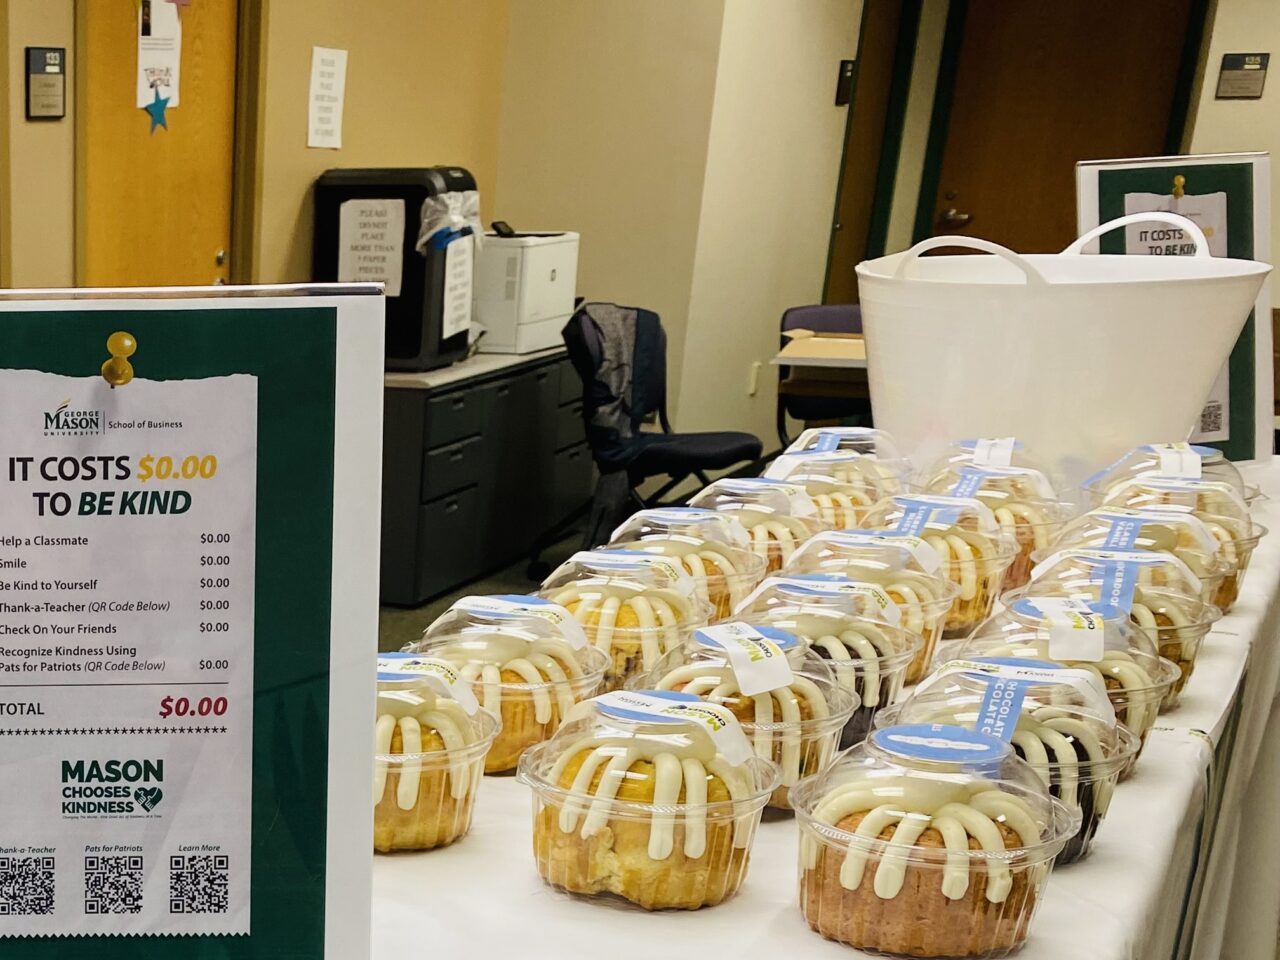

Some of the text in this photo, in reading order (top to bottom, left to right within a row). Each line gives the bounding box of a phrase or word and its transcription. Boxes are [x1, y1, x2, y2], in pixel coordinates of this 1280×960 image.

[1140, 229, 1183, 242] IT COSTS
[1149, 244, 1198, 255] TO BE KIN
[44, 412, 99, 430] MASON
[108, 420, 183, 429] School of Business
[9, 454, 217, 482] IT COSTS $0.00
[33, 490, 192, 516] TO BE KIND
[34, 535, 88, 546] Classmate
[200, 533, 230, 544] $0.00
[200, 555, 230, 566] $0.00
[14, 580, 38, 591] Kind
[41, 581, 52, 590] to
[54, 579, 97, 590] Yourself
[200, 578, 229, 588] $0.00
[88, 602, 106, 613] (QR
[108, 601, 134, 612] Code
[136, 600, 170, 612] Below)
[200, 600, 229, 610] $0.00
[33, 625, 48, 634] On
[51, 625, 74, 634] Your
[77, 624, 117, 634] Friends
[200, 622, 229, 633] $0.00
[55, 646, 103, 656] Kindness
[106, 646, 136, 657] Using
[23, 662, 38, 672] for
[40, 661, 81, 672] Patriots
[84, 661, 103, 673] (QR
[104, 660, 129, 671] Code
[132, 660, 165, 672] Below)
[200, 659, 228, 670] $0.00
[159, 696, 228, 718] $0.00
[62, 760, 163, 783] MASON
[62, 786, 131, 798] CHOOSES
[62, 801, 134, 813] KINDNESS
